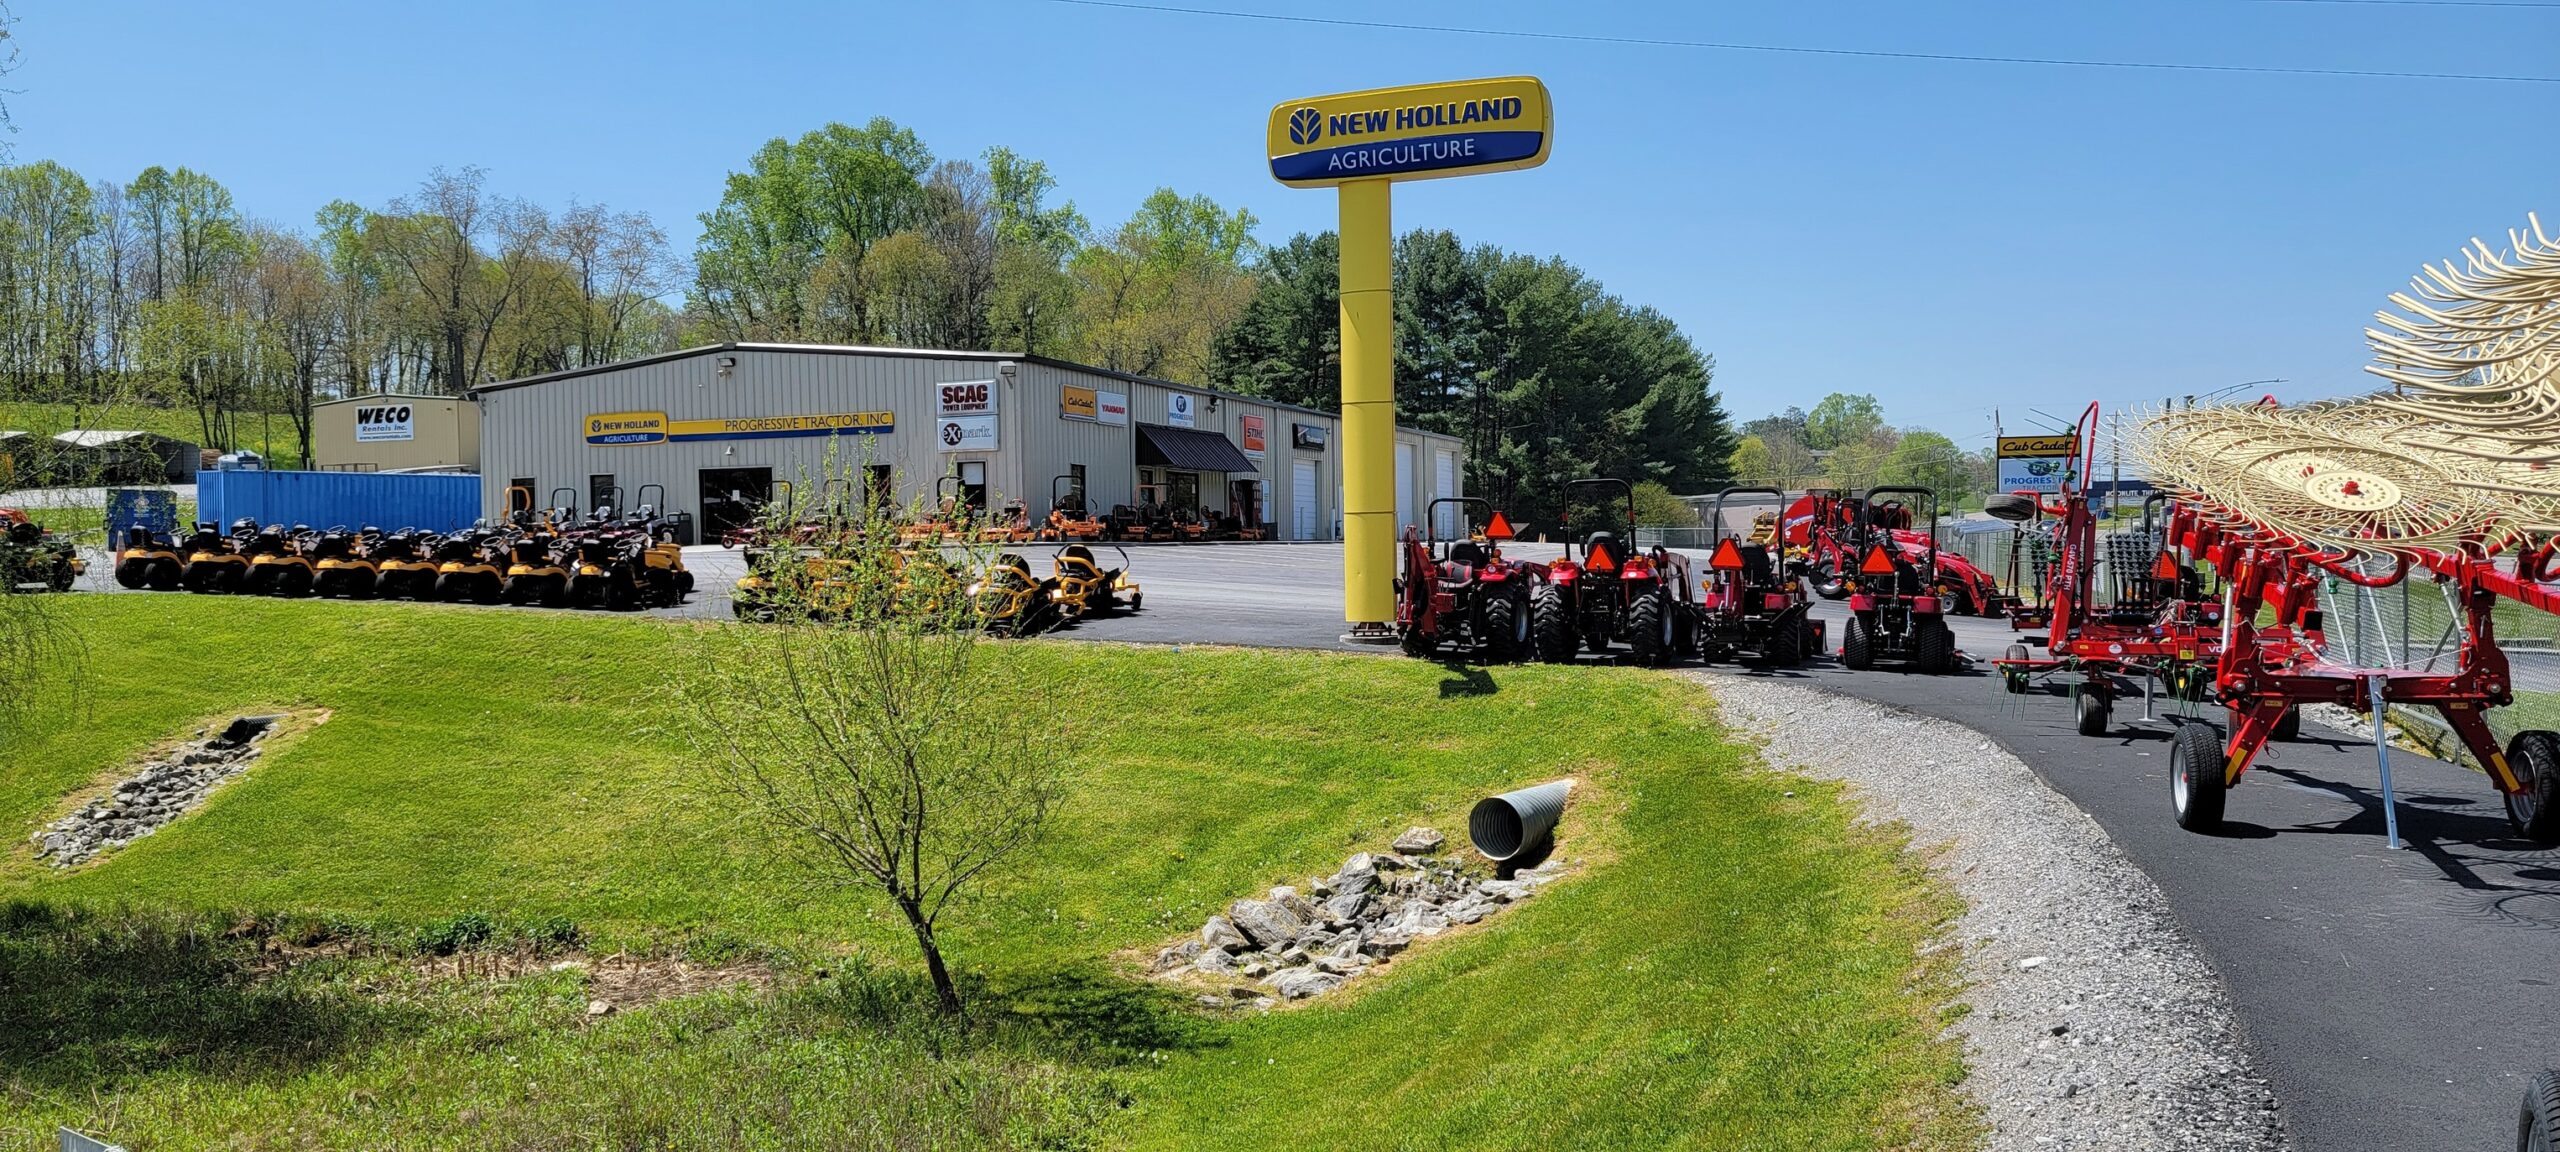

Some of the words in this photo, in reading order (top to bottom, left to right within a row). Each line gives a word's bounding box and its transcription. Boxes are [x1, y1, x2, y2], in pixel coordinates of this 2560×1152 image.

[1329, 110, 1389, 136] NEW
[1395, 96, 1522, 130] HOLLAND
[1328, 138, 1475, 171] AGRICULTURE
[942, 384, 988, 404] SCAG
[358, 407, 410, 424] WECO
[1101, 404, 1125, 414] YANMAR
[603, 422, 622, 430] NEW
[624, 420, 660, 429] HOLLAND
[725, 417, 799, 431] PROGRESSIVE
[866, 412, 892, 425] INC.
[604, 434, 648, 443] AGRICULTURE
[1247, 428, 1264, 439] STIHL
[2003, 441, 2029, 451] Cub
